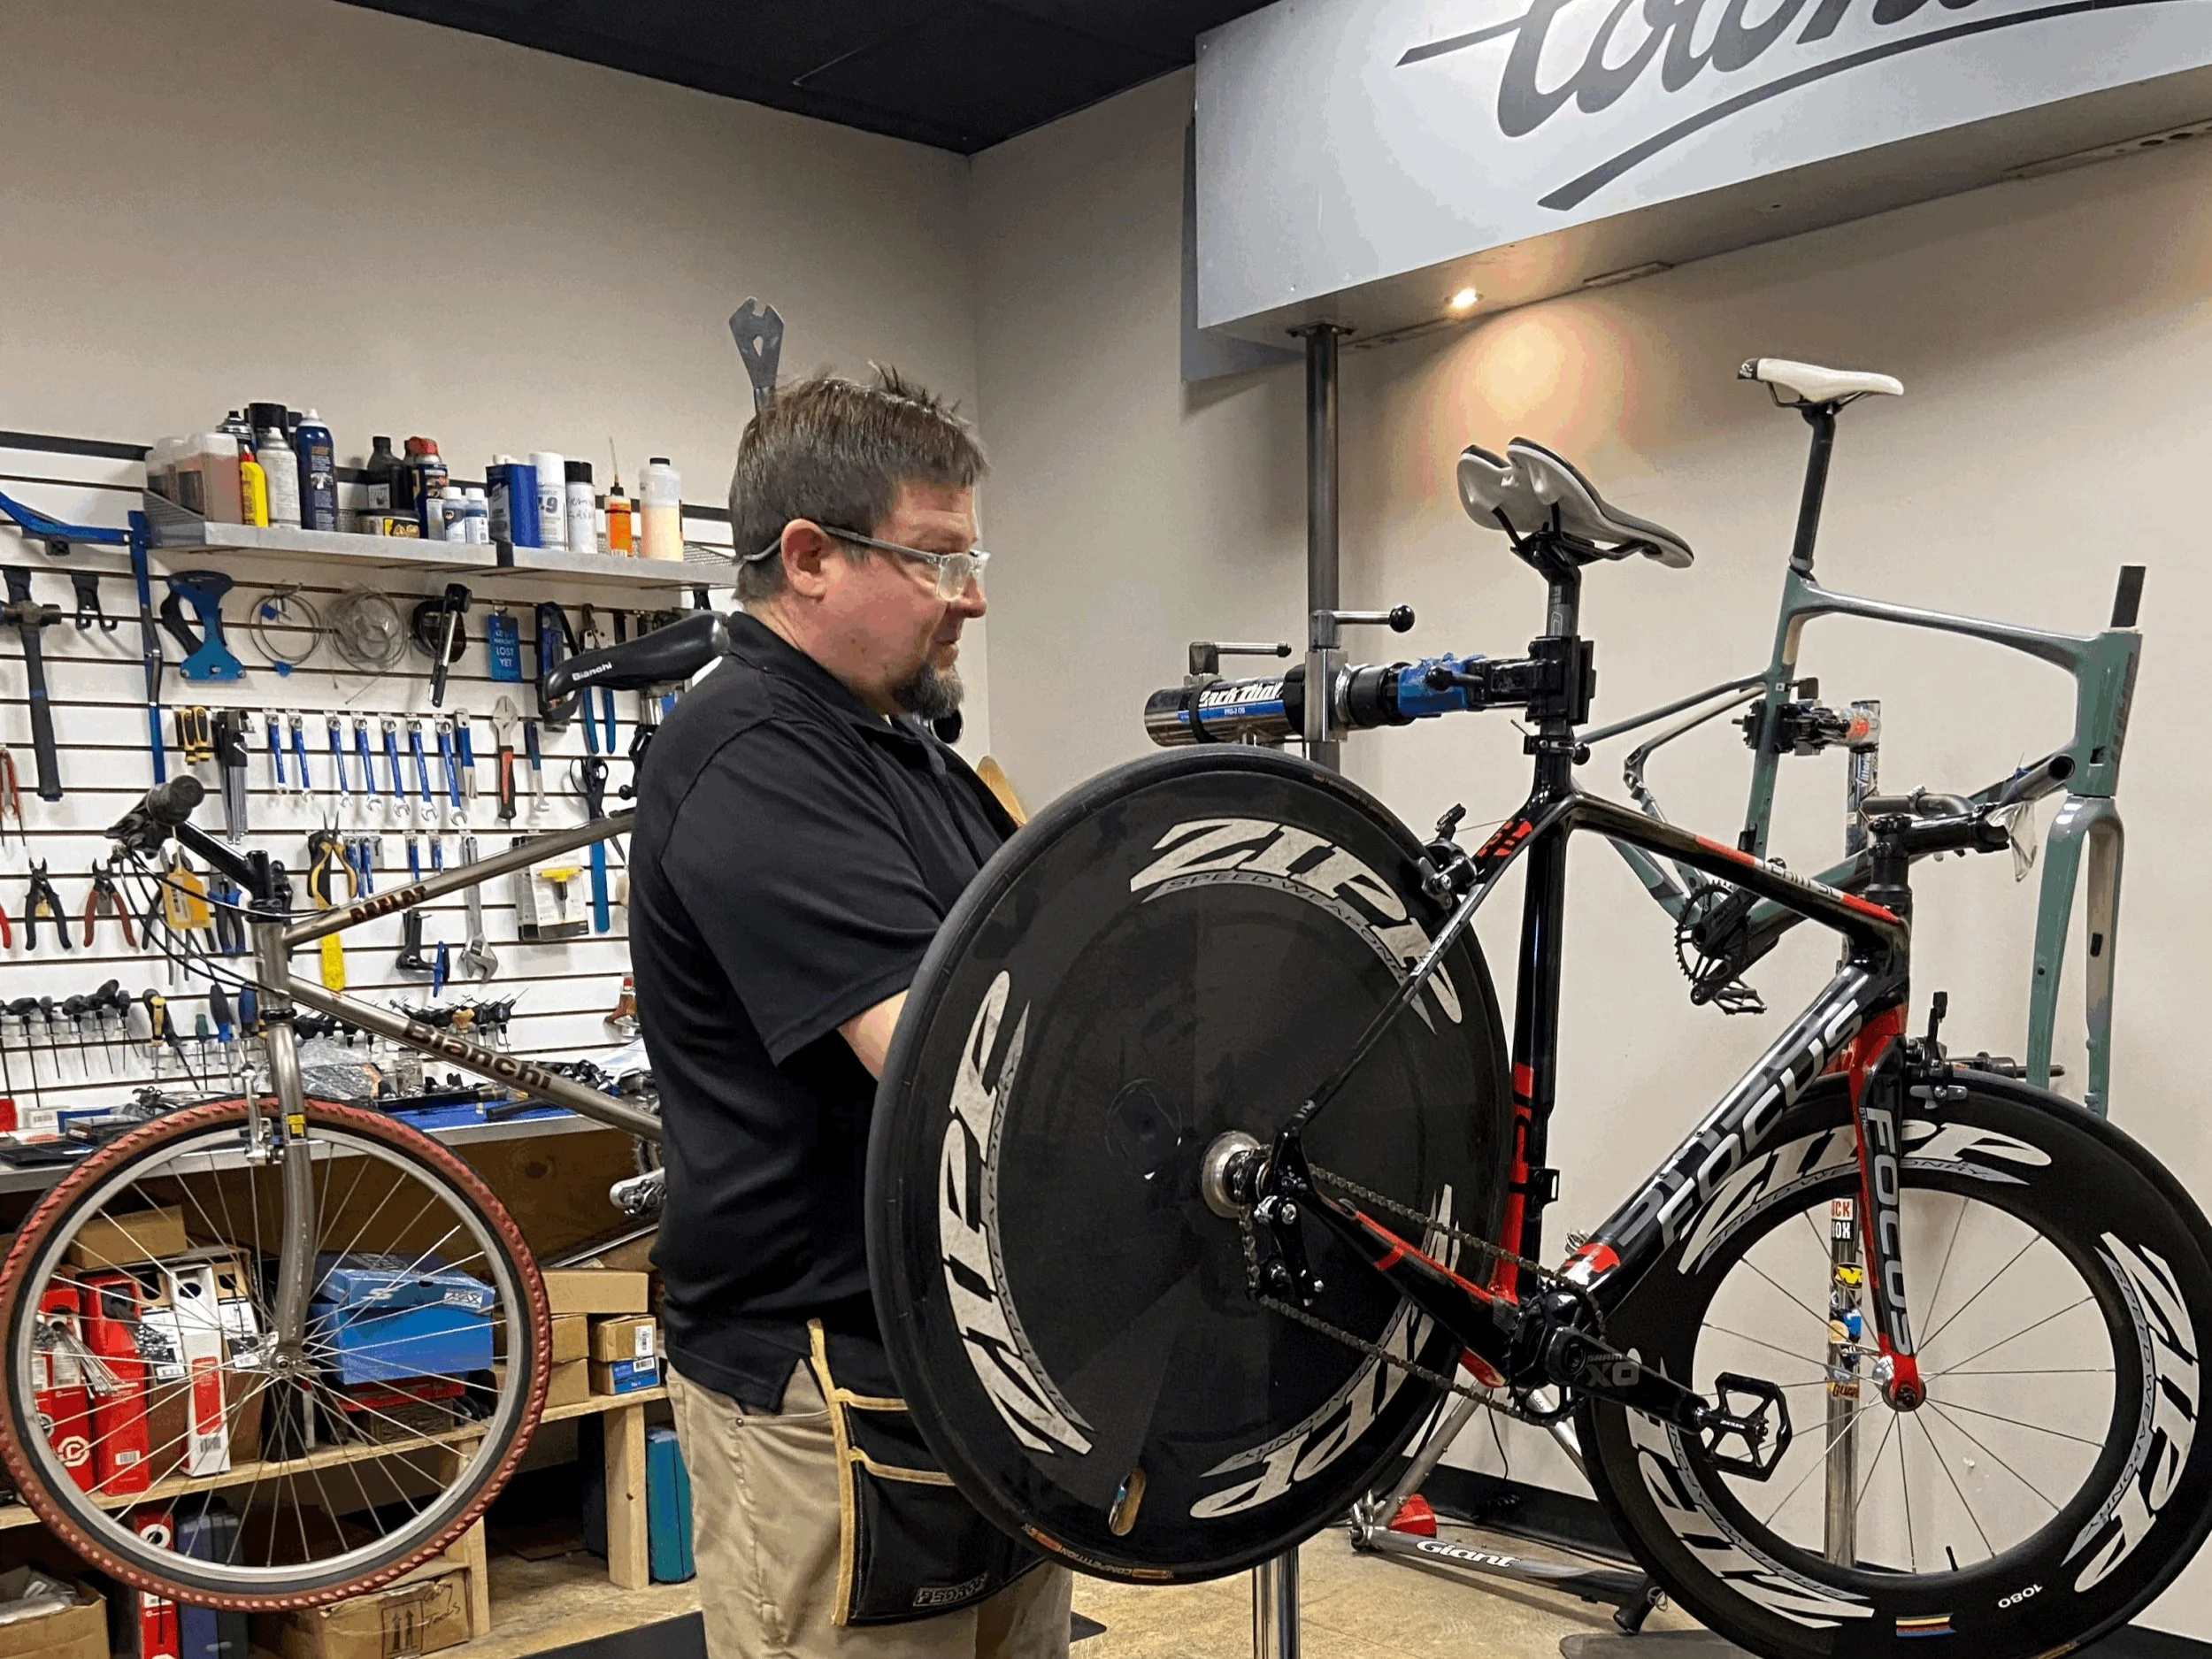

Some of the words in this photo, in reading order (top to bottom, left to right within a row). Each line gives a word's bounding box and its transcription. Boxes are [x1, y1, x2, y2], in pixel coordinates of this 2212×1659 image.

[496, 646, 514, 656] LOST
[499, 658, 512, 667] YET
[572, 662, 612, 681] Bianchi
[1199, 687, 1239, 707] Park
[1130, 817, 1462, 1024] ZIPP
[1168, 871, 1272, 890] SPEED
[1281, 881, 1407, 979] WEAPONR
[403, 1018, 552, 1089] Bianchi
[1656, 999, 1863, 1249] FOCUS
[939, 971, 1093, 1455] ZIPP
[1708, 1187, 1792, 1254] SPEED
[1832, 1221, 1851, 1239] OX
[1866, 1107, 1914, 1355] FOCUS
[2112, 1265, 2151, 1362] SPEED
[1586, 1353, 1624, 1363] SRAM
[2074, 1231, 2200, 1593] ZIPP
[2084, 1372, 2154, 1538] WEAPONRY
[1061, 1547, 1133, 1576] COMPETITION
[1417, 1540, 1521, 1568] Giant
[1998, 1583, 2043, 1609] 1080
